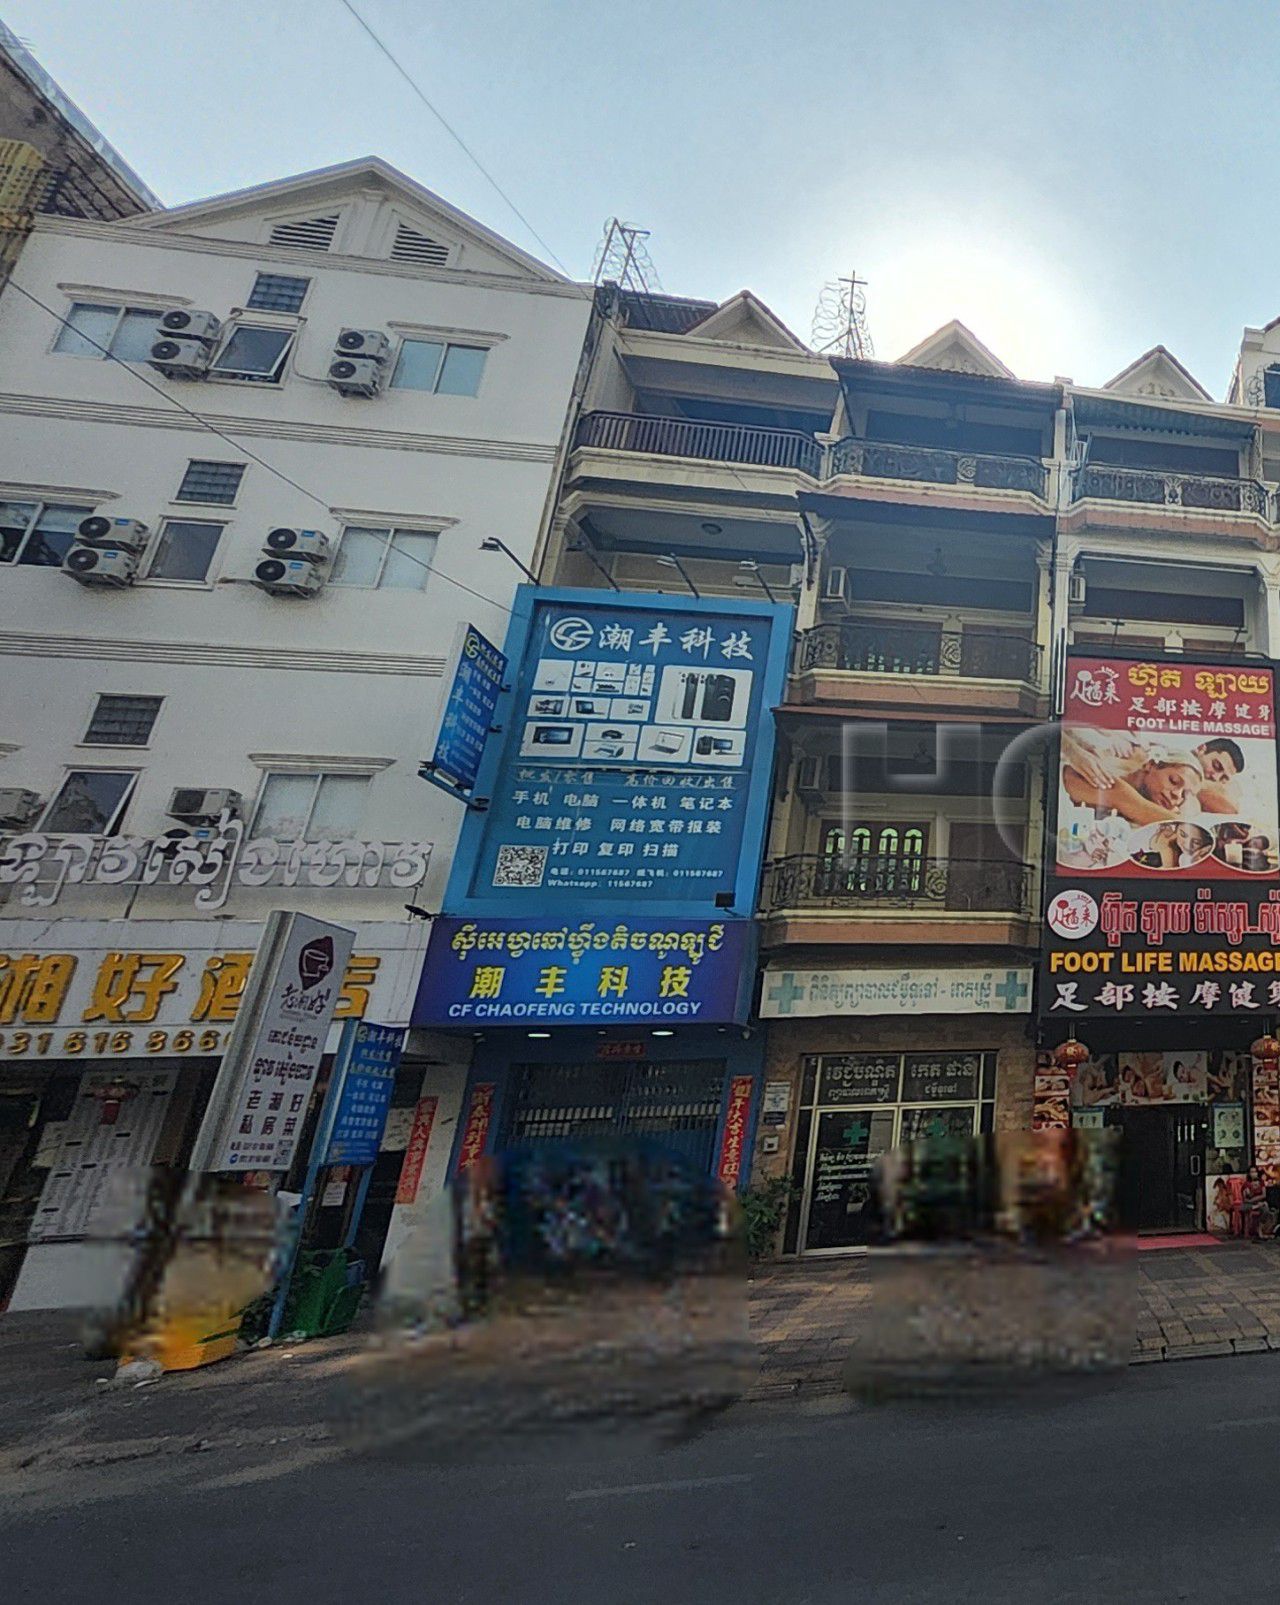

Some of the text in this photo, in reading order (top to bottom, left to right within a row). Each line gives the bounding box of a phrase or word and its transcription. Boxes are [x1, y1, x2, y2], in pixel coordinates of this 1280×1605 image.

[598, 622, 755, 661] 潮丰科技
[1127, 697, 1270, 721] 足部按摩健身
[1127, 717, 1269, 735] FOOT LIFE MASSAGE
[512, 790, 733, 810] 手机 电脑 一体机 笔记本
[515, 816, 722, 834] 电脑维修 网络宽带报装
[552, 840, 679, 858] 打印 复印 扫描
[1050, 952, 1114, 973] FOOT
[1121, 952, 1173, 973] LIFE
[469, 965, 692, 998] 潮丰科技
[448, 1001, 701, 1017] CF CHAOFENG TECHNOLOGY
[0, 1029, 232, 1054] 31 616 866
[239, 1114, 297, 1136] 私房菜
